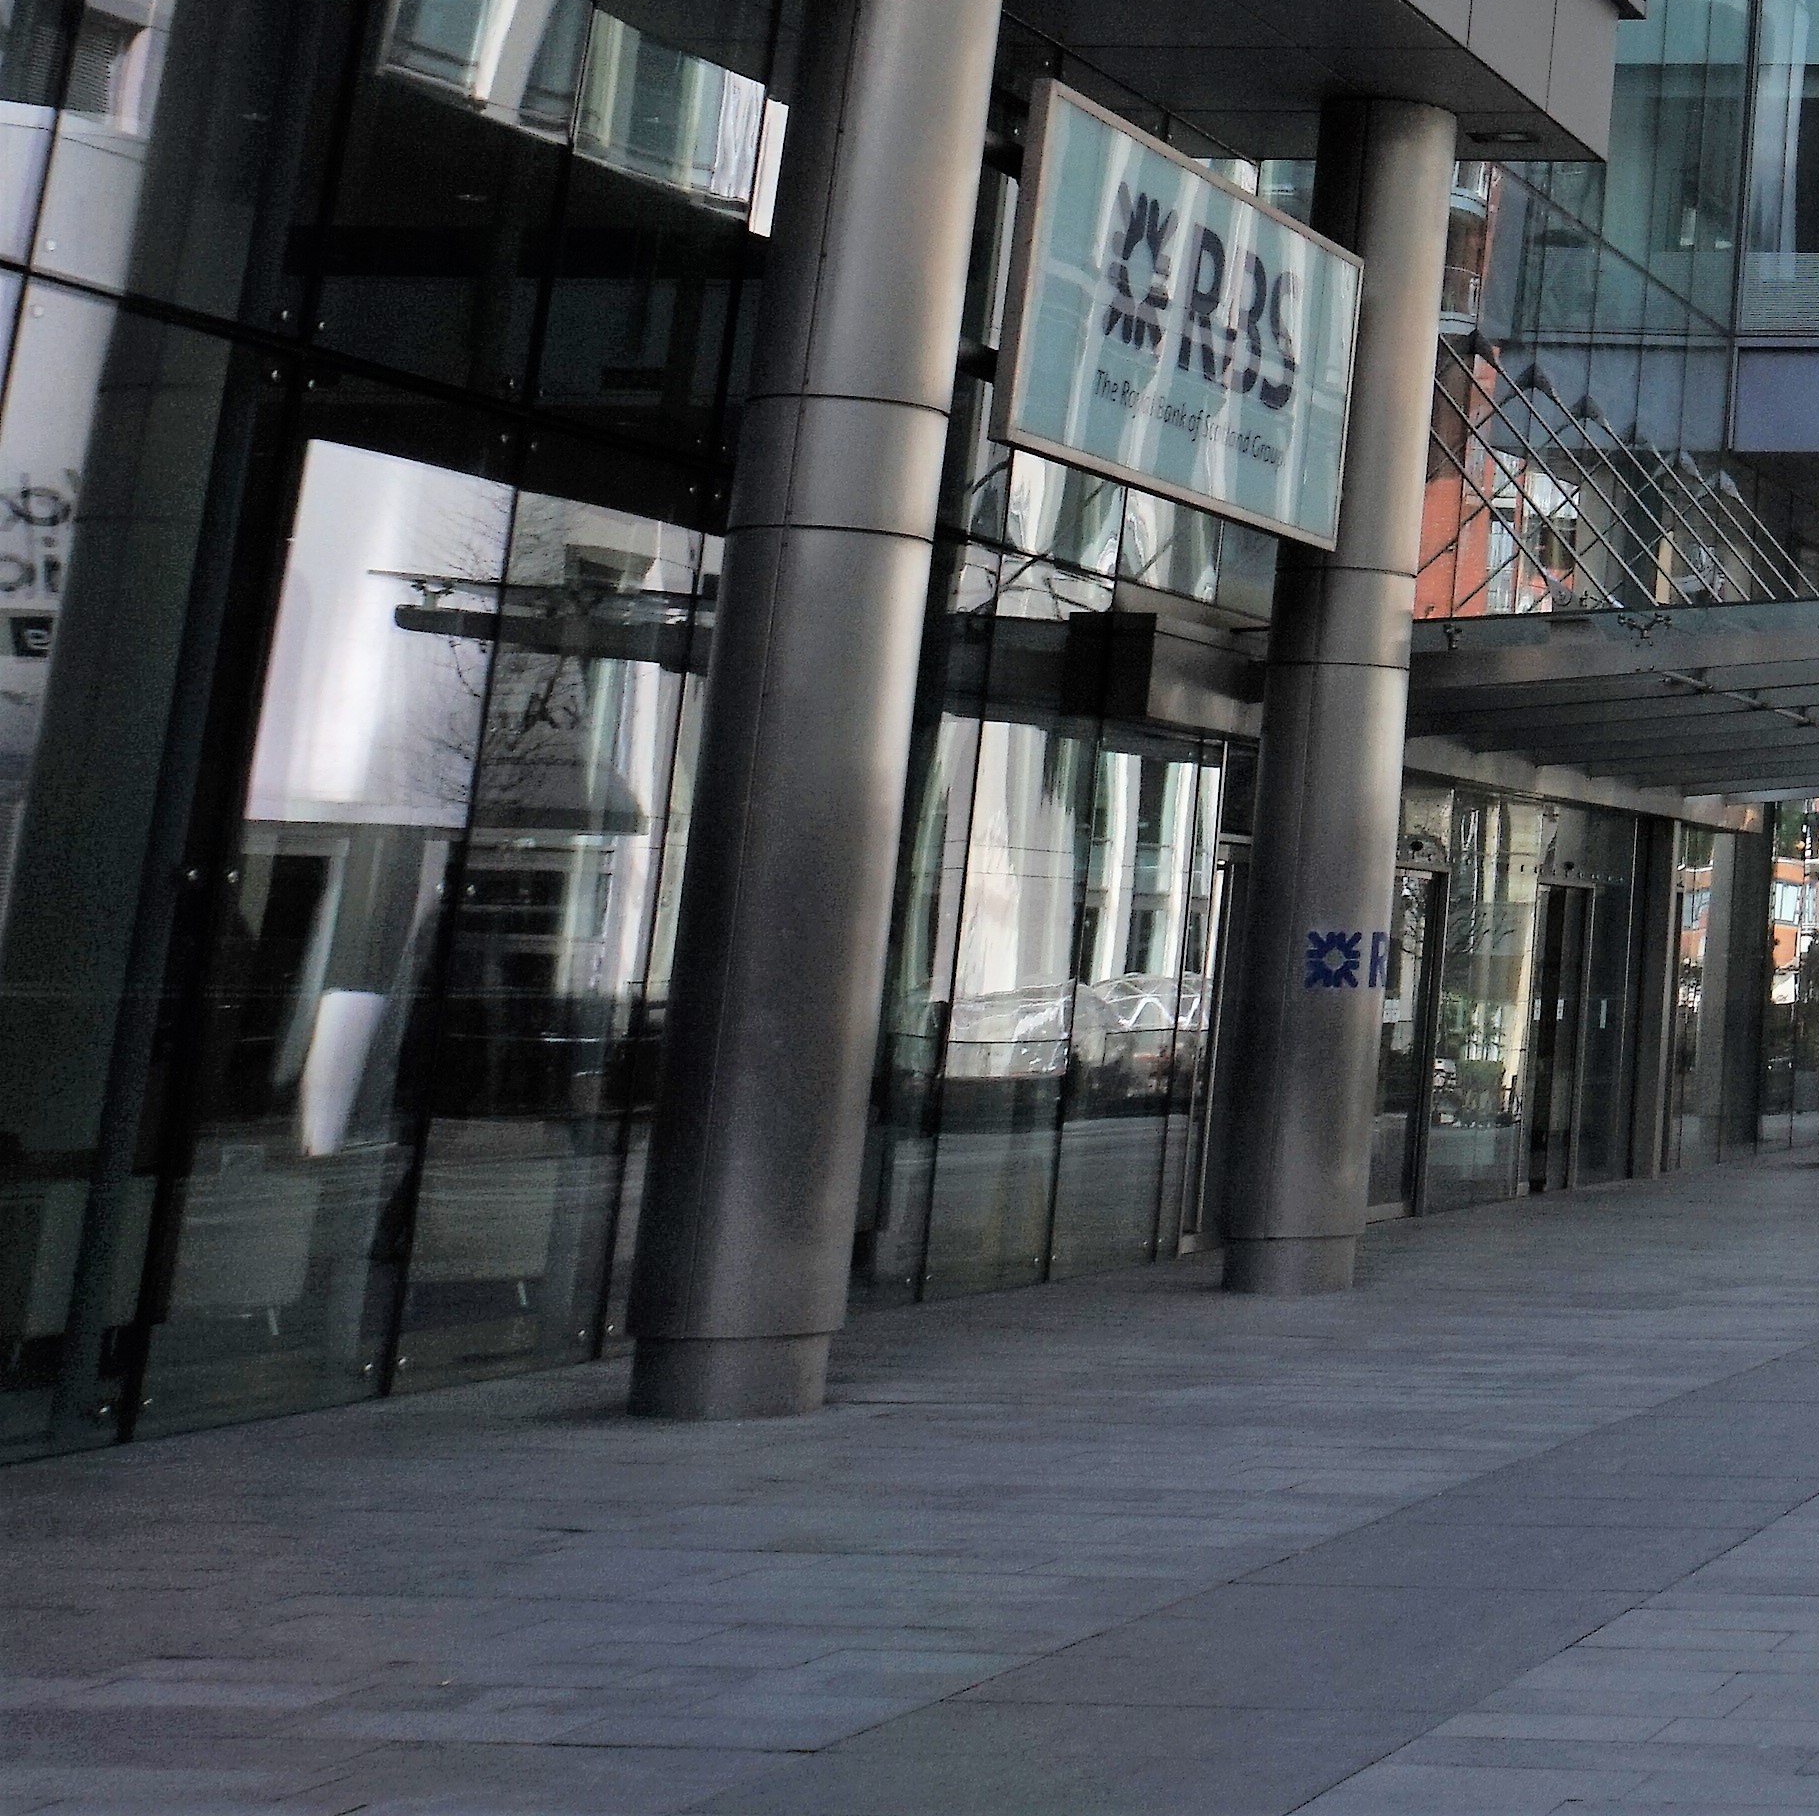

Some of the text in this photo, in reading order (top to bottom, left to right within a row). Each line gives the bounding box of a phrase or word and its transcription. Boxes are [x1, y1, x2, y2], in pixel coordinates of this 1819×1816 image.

[1177, 223, 1301, 410] RBS
[1096, 369, 1118, 402] The
[1158, 396, 1187, 430] Bank
[1188, 409, 1205, 442] of
[1203, 414, 1252, 454] Scoland
